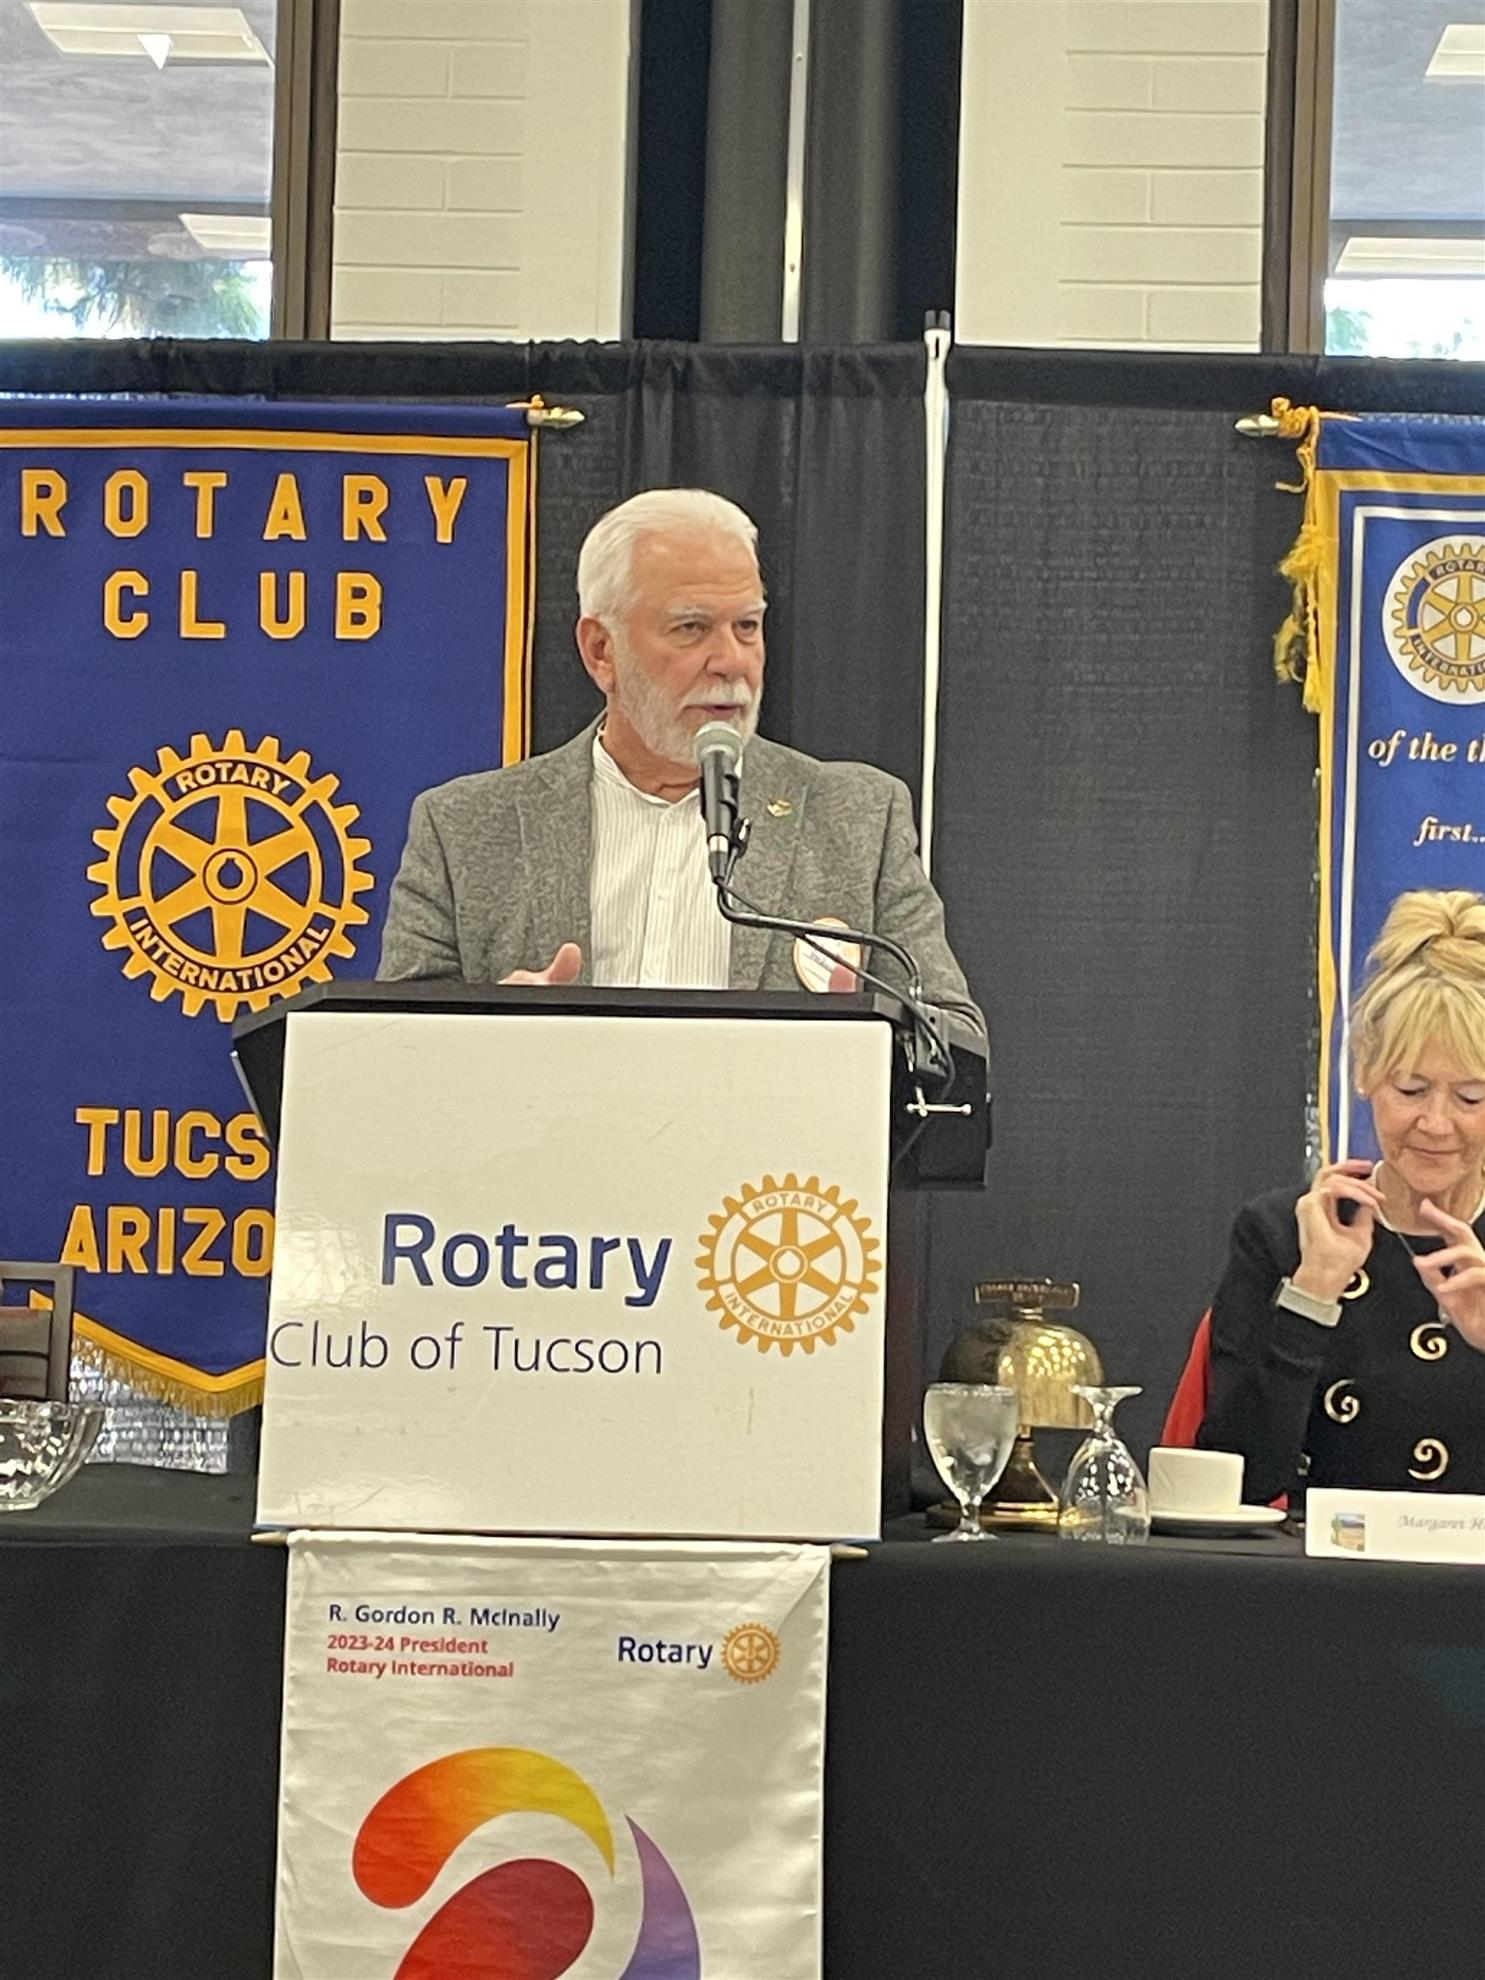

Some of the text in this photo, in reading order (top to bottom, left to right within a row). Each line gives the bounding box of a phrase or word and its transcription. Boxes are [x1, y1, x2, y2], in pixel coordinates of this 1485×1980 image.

[20, 467, 468, 543] ROTARY
[103, 570, 384, 640] CLUB
[1368, 730, 1407, 767] of
[1409, 732, 1458, 762] the
[175, 762, 291, 795] ROTARY
[130, 918, 330, 991] INTERNATIONAL
[752, 1193, 829, 1213] ROTARY
[381, 1213, 672, 1307] Rotary
[725, 1292, 853, 1336] INTERNATIONAL
[270, 1321, 662, 1374] Club of Tucson
[329, 1604, 561, 1632] R. Gordon R. McInally
[327, 1634, 488, 1653] 2023-24 President
[618, 1636, 713, 1669] Rotary
[327, 1657, 514, 1678] Rotary International
